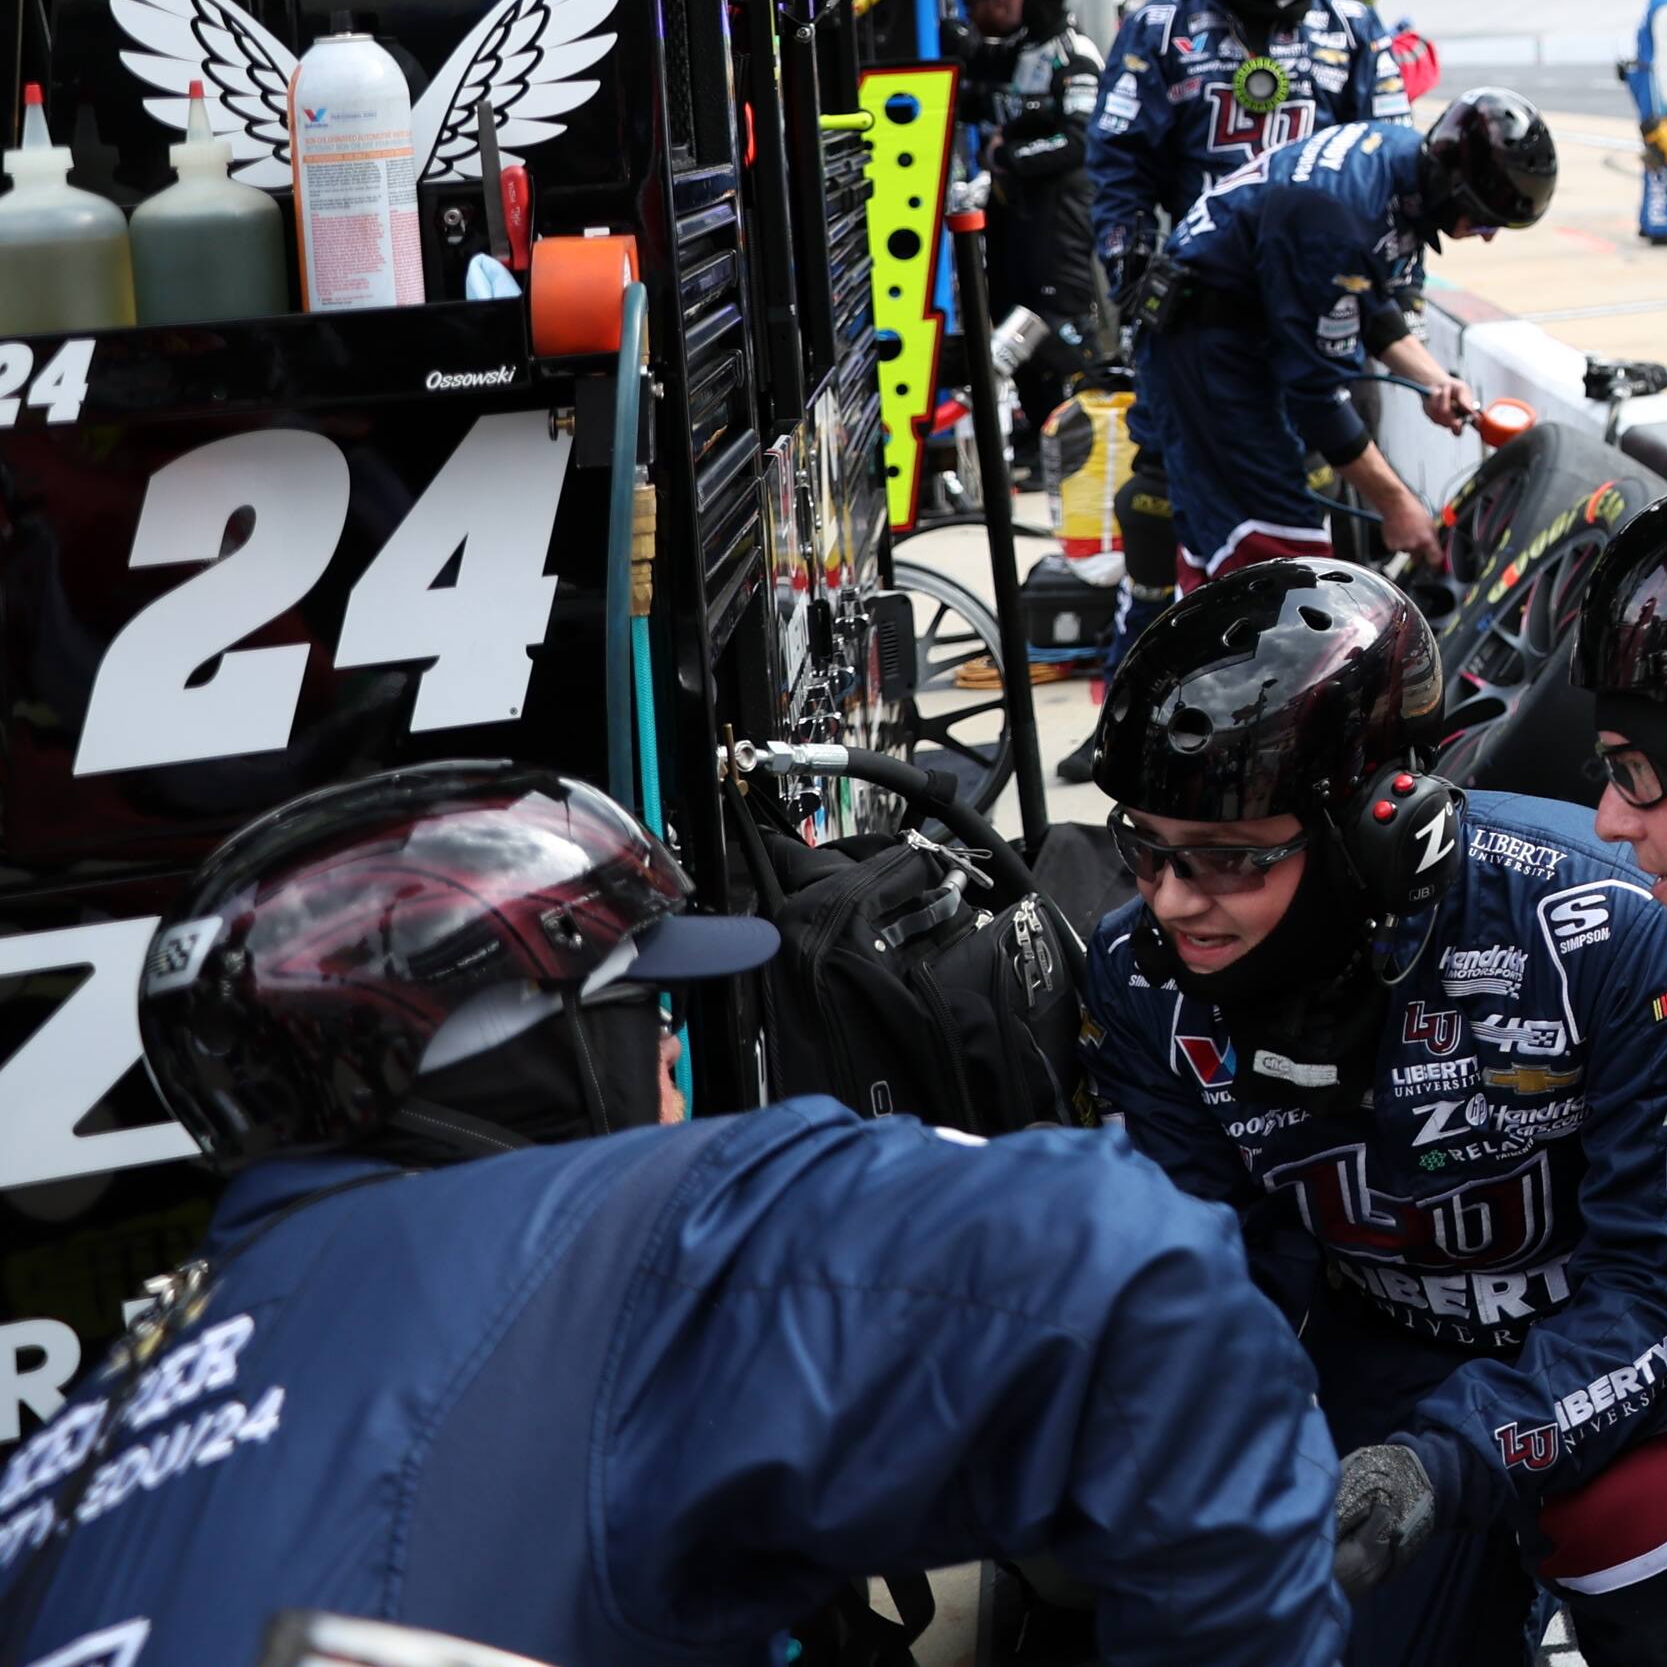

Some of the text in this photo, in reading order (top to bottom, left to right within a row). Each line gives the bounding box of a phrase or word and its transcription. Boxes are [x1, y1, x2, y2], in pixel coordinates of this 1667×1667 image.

[426, 365, 517, 390] Ossowski
[73, 407, 576, 779] 24
[1414, 806, 1456, 875] Z
[1470, 828, 1568, 870] LIBERTY
[1468, 846, 1556, 881] UNIVERSITY
[1560, 927, 1611, 955] SIMPSON
[1391, 1053, 1480, 1086] LIBERTY
